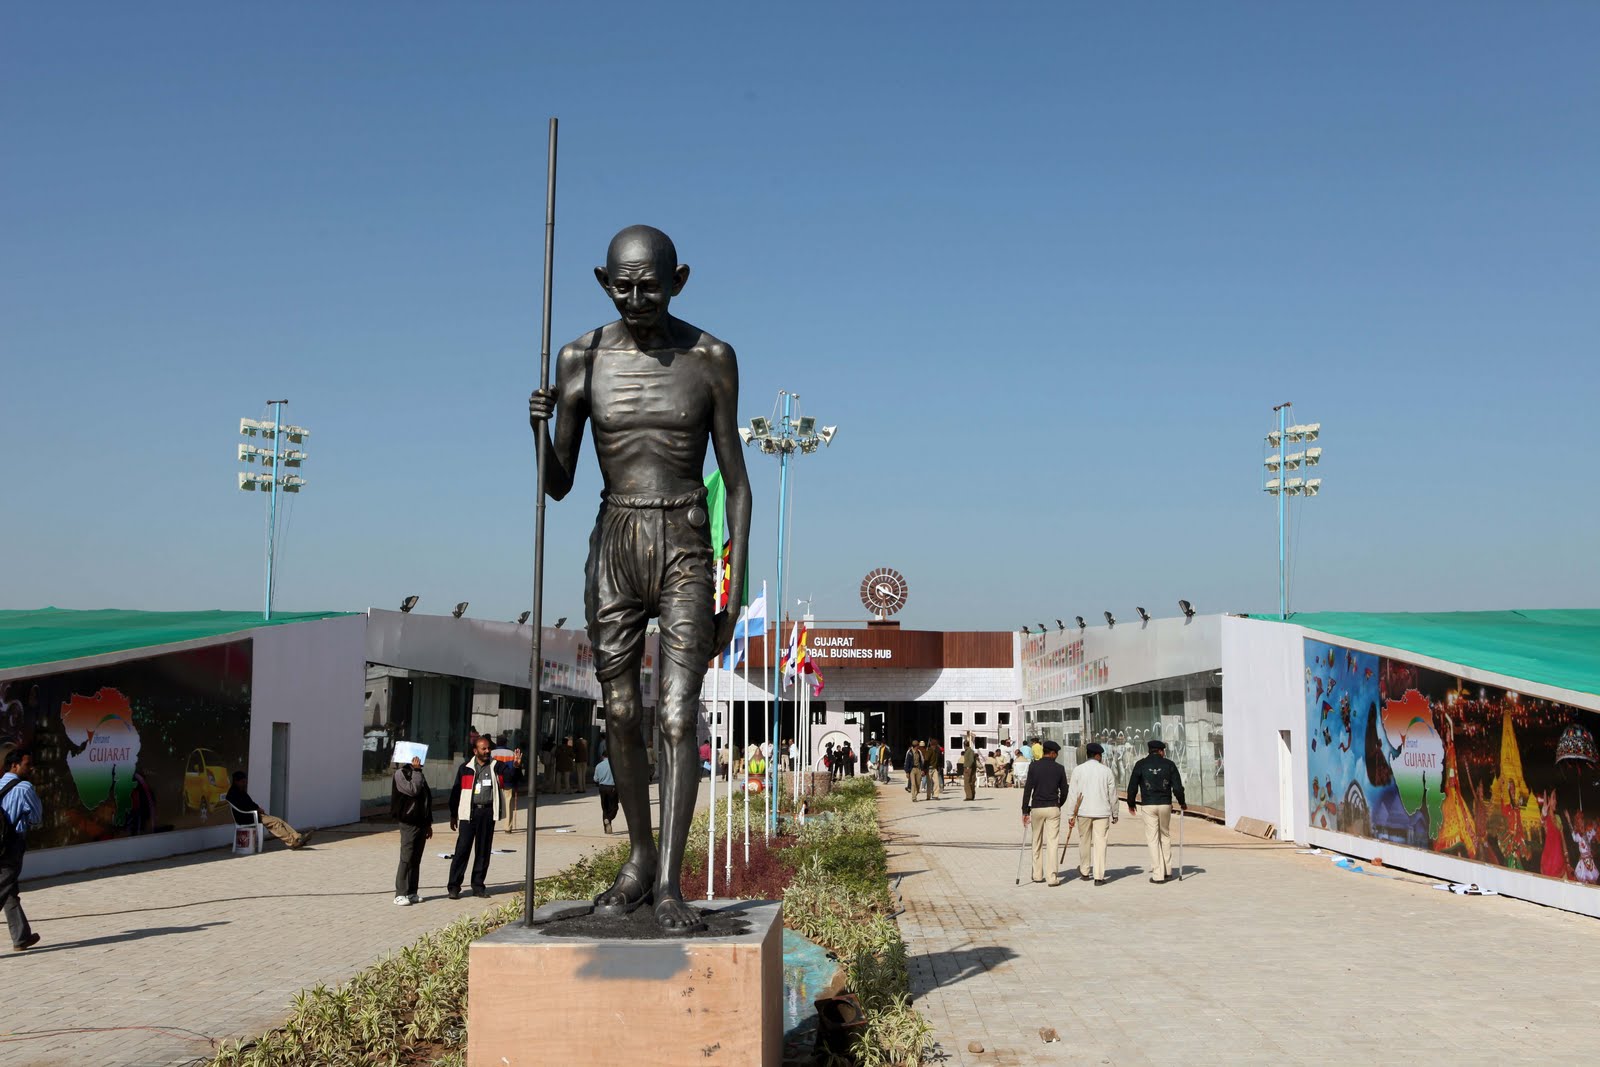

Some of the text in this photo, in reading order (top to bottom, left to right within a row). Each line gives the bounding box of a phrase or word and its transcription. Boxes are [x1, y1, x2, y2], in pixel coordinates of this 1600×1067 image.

[814, 637, 854, 647] GUJARAT
[830, 649, 872, 658] BUSINESS
[874, 649, 892, 659] HUB
[89, 747, 131, 762] GUJARAT
[1404, 752, 1436, 768] GUJARAT
